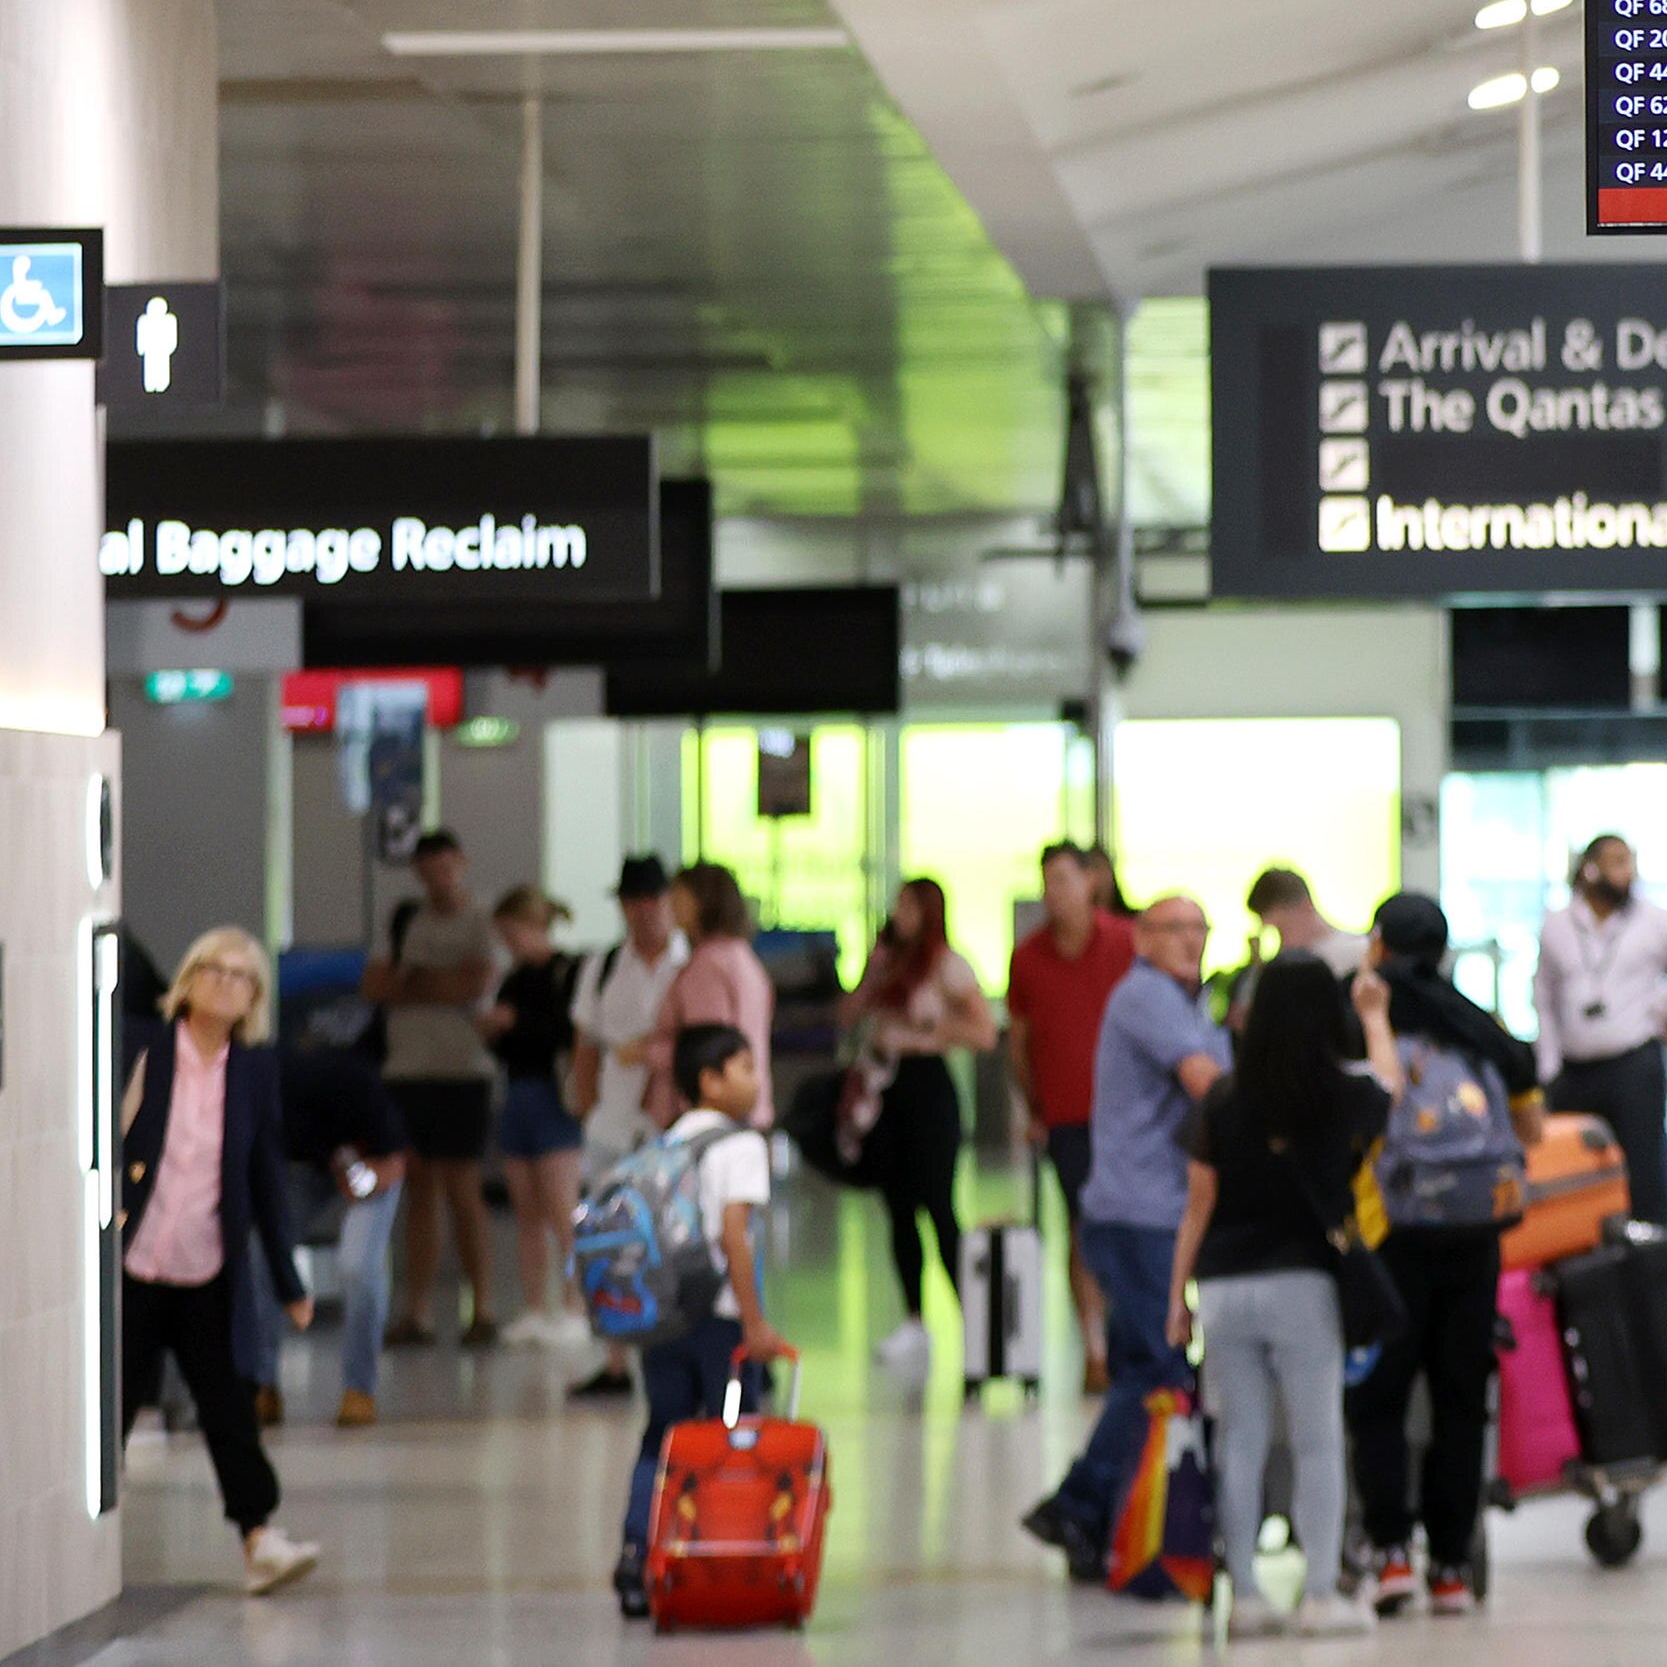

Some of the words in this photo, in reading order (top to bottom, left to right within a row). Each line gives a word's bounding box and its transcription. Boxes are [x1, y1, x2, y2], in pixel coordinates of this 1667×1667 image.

[1616, 162, 1646, 184] QF
[1379, 316, 1547, 374] Arrival
[1561, 317, 1601, 373] &
[1378, 377, 1474, 434] The
[1486, 377, 1664, 440] Qantas
[156, 518, 381, 587] Baggage
[392, 511, 586, 572] Reclaim
